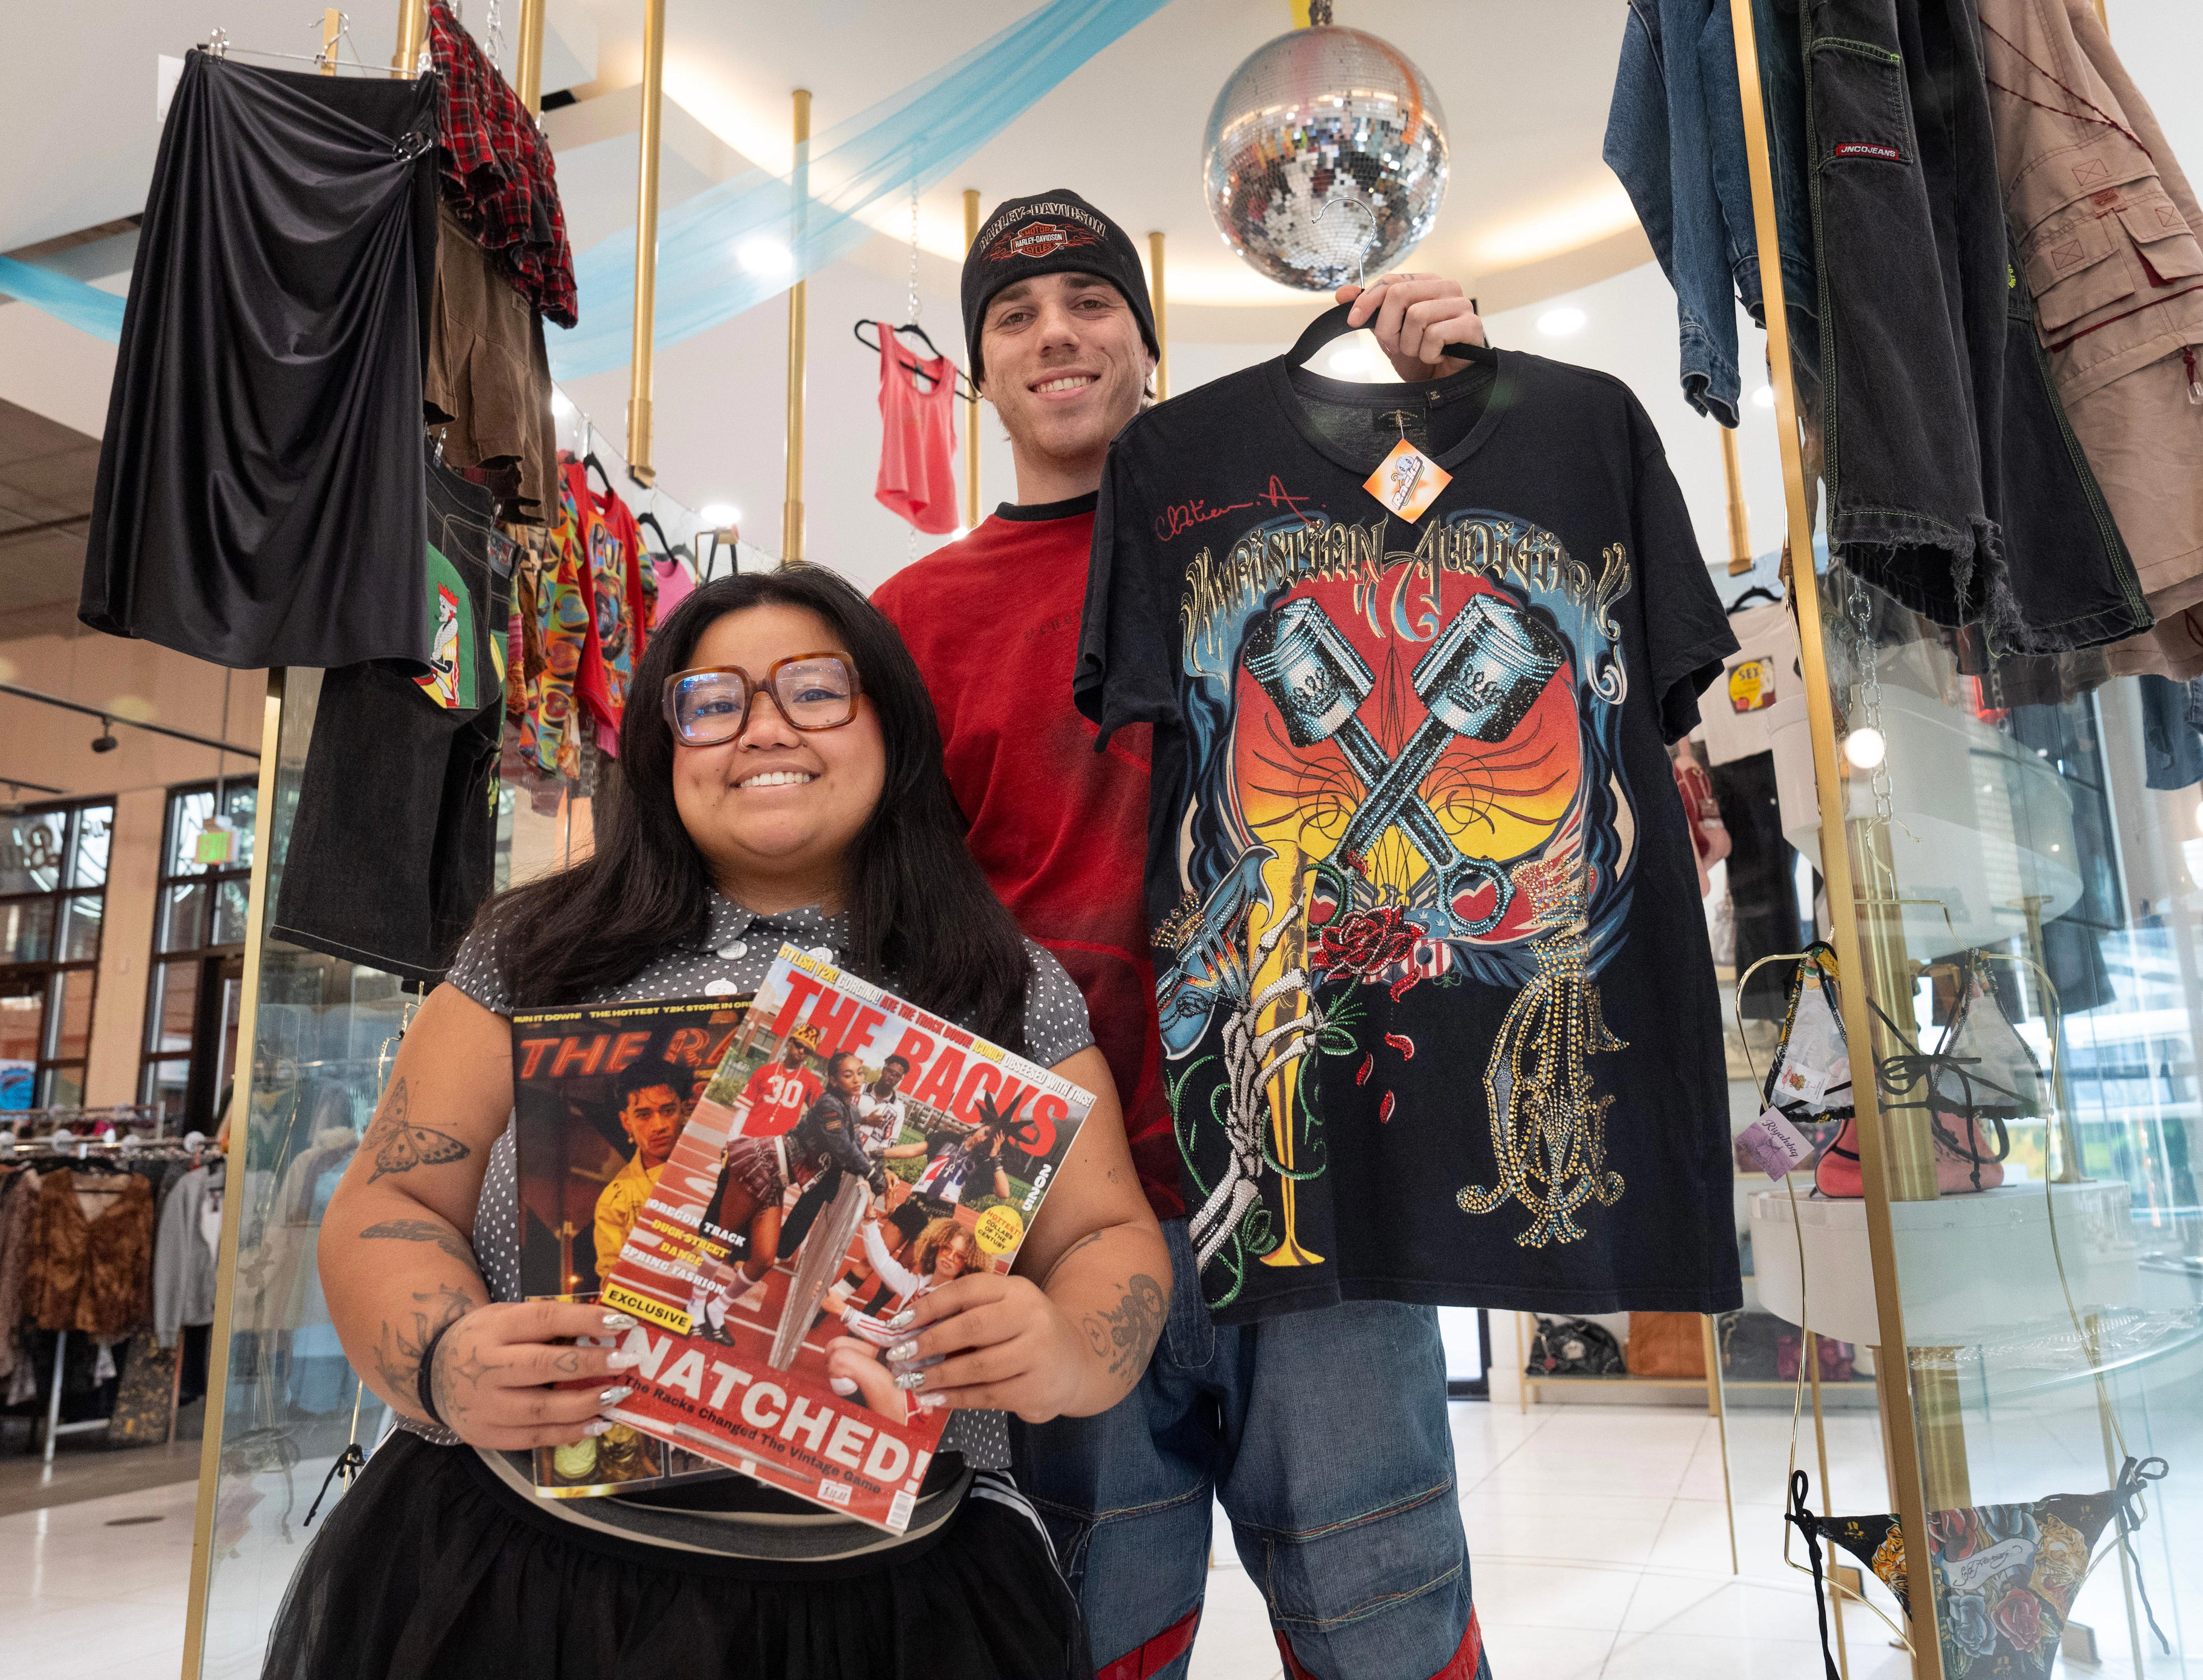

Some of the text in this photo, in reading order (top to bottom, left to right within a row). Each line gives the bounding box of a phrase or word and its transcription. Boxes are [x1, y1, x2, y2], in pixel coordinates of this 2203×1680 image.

[979, 202, 1107, 252] HARLEY-DAVIDSON
[1015, 233, 1063, 248] HARLEY-DAVIDSON
[1025, 225, 1050, 235] MOTOR
[1026, 243, 1052, 254] CYCLES
[590, 1010, 612, 1019] THE
[612, 1006, 660, 1017] HOTTEST
[685, 1003, 720, 1012] STORE
[720, 1001, 733, 1010] IN
[778, 944, 817, 973] STYLISH
[816, 962, 840, 984] Y2K!
[879, 995, 900, 1013] ATE
[897, 1003, 917, 1021] THE
[915, 1011, 946, 1035] TRACK
[942, 1025, 975, 1049] DOWN!
[972, 1040, 1006, 1064] ICONIC!
[1046, 1075, 1073, 1097] WITH
[1070, 1085, 1094, 1108] THIS!
[521, 1030, 651, 1080] THE
[771, 970, 1068, 1157] THE RACKS
[763, 1074, 804, 1108] 30
[1022, 1163, 1052, 1212] 2025
[649, 1198, 747, 1247] OREGON TRACK
[977, 1229, 1006, 1250] CENTURY
[986, 1219, 1013, 1240] COLLABS
[994, 1232, 1007, 1243] THE
[621, 1245, 727, 1295] SPRING FASHION
[608, 1289, 690, 1328] EXCLUSIVE
[625, 1374, 882, 1494] The Racks Changed The Vintage Game
